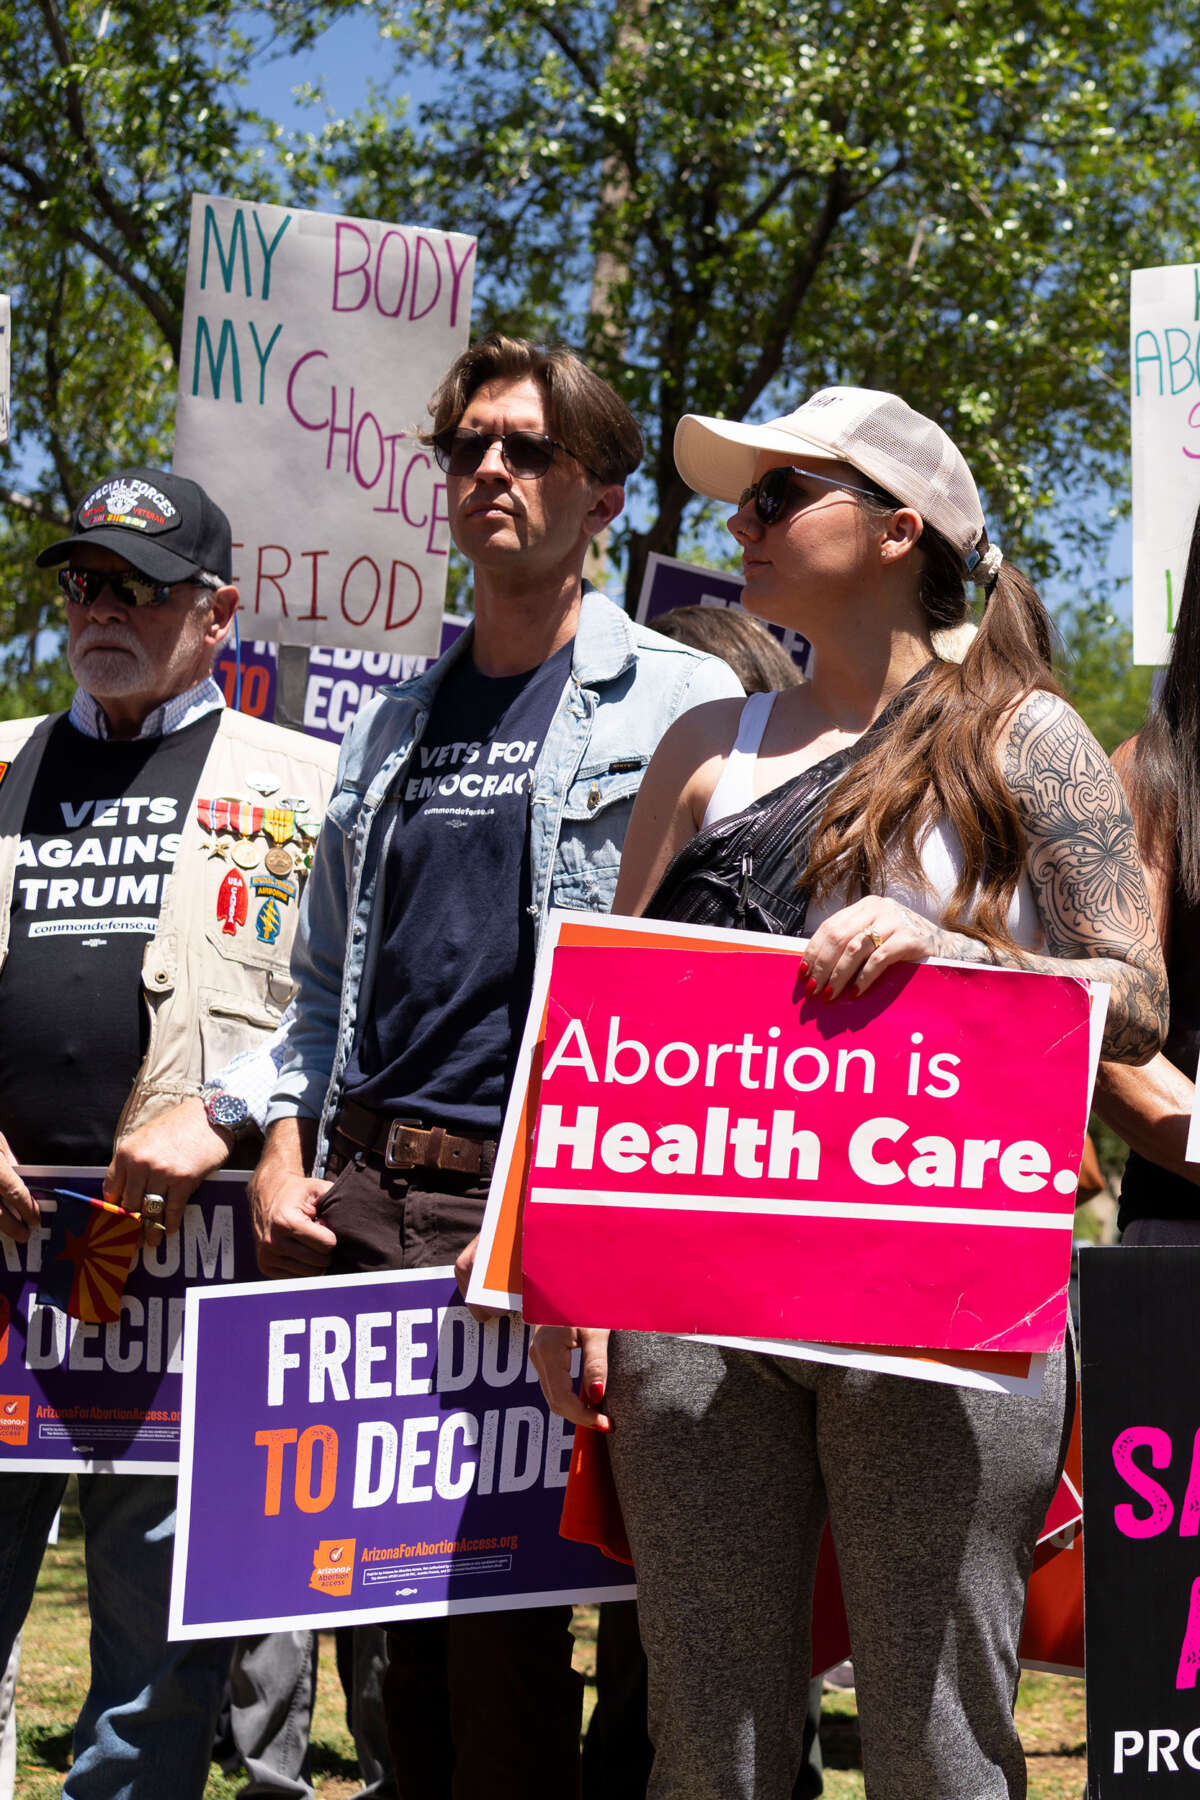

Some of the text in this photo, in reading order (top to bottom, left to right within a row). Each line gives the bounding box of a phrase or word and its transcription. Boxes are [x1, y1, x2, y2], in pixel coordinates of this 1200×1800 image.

[200, 204, 476, 328] MY BODY
[192, 315, 448, 555] MY CHOICE
[130, 480, 176, 517] FORCES
[420, 742, 482, 769] VETS
[60, 797, 178, 828] VETS
[15, 834, 183, 868] AGAINS
[542, 1016, 961, 1098] Abortion is
[535, 1104, 1079, 1194] Health Care.
[254, 1405, 576, 1516] TO DECIDE
[361, 1535, 518, 1563] ArizonaForAbortionAccess.org
[317, 1566, 346, 1575] Arizona
